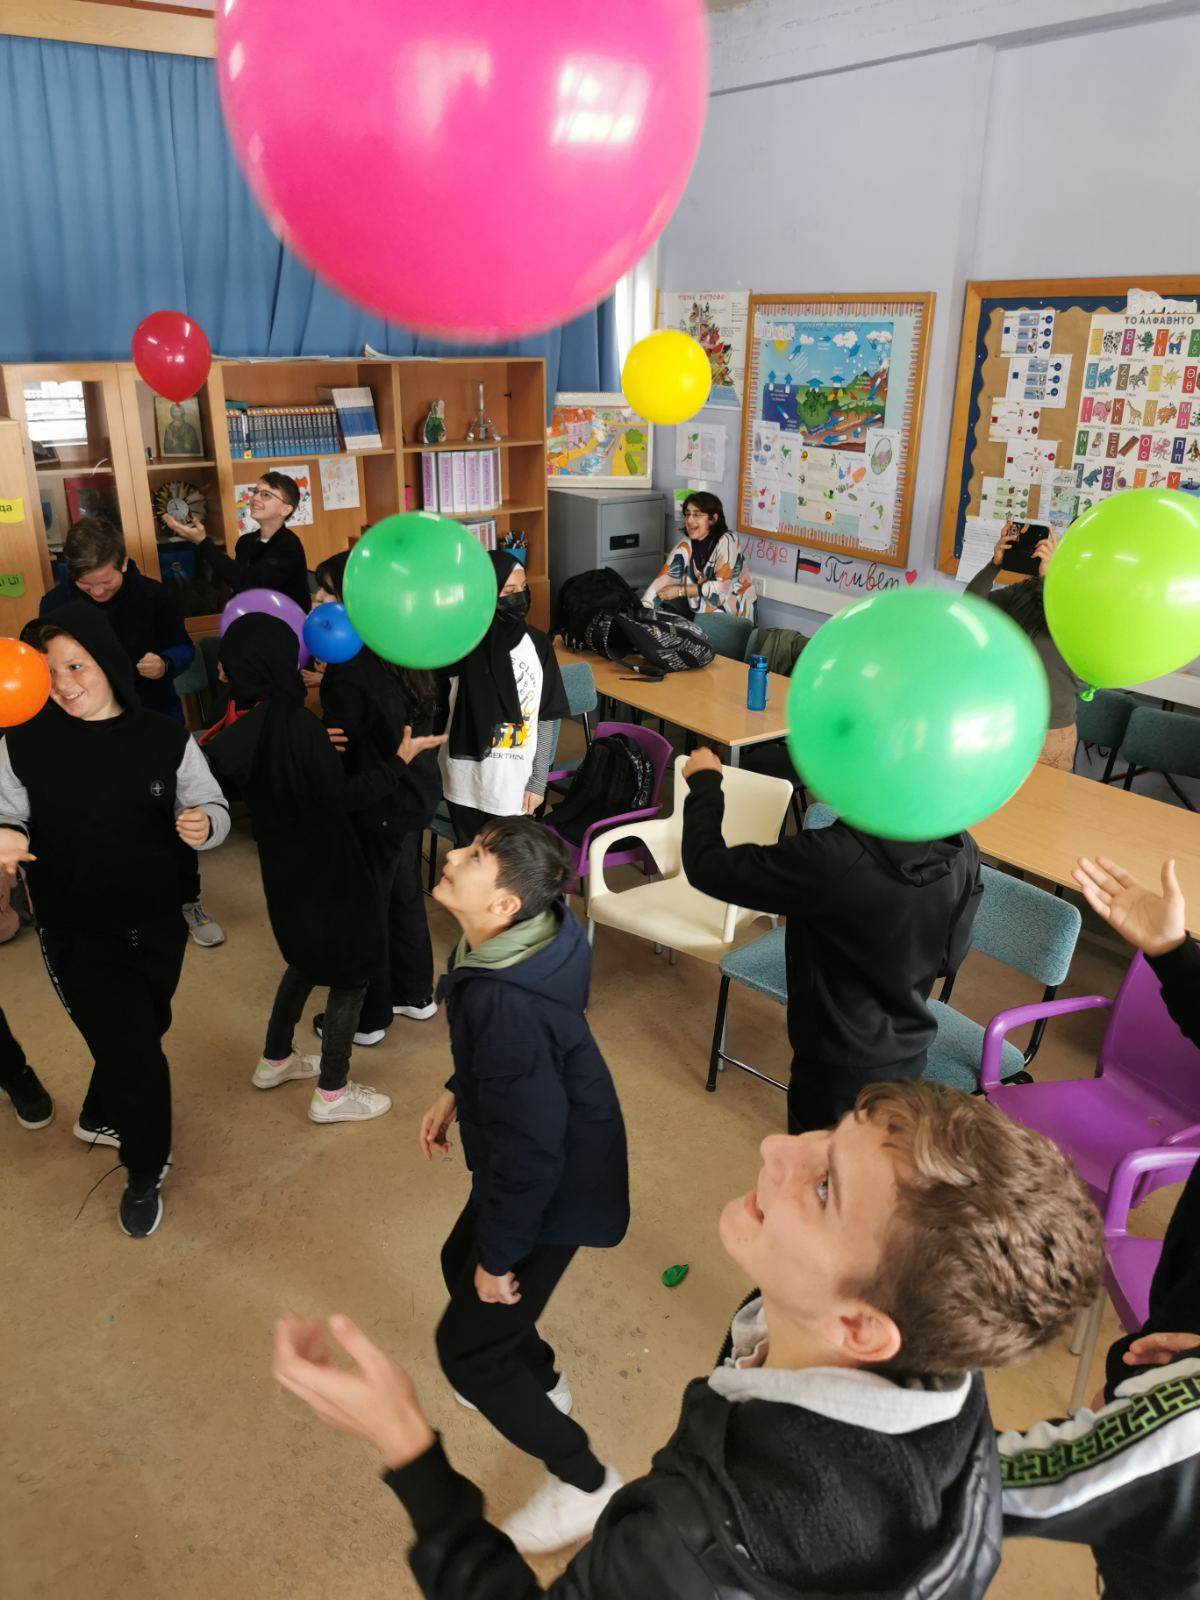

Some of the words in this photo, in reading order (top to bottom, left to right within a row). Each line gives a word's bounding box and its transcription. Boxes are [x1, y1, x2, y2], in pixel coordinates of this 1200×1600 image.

[1124, 316, 1137, 325] ΤΟ
[1139, 316, 1195, 325] ΑΛΦΑΒΗΤΟ
[825, 555, 900, 591] Привет
